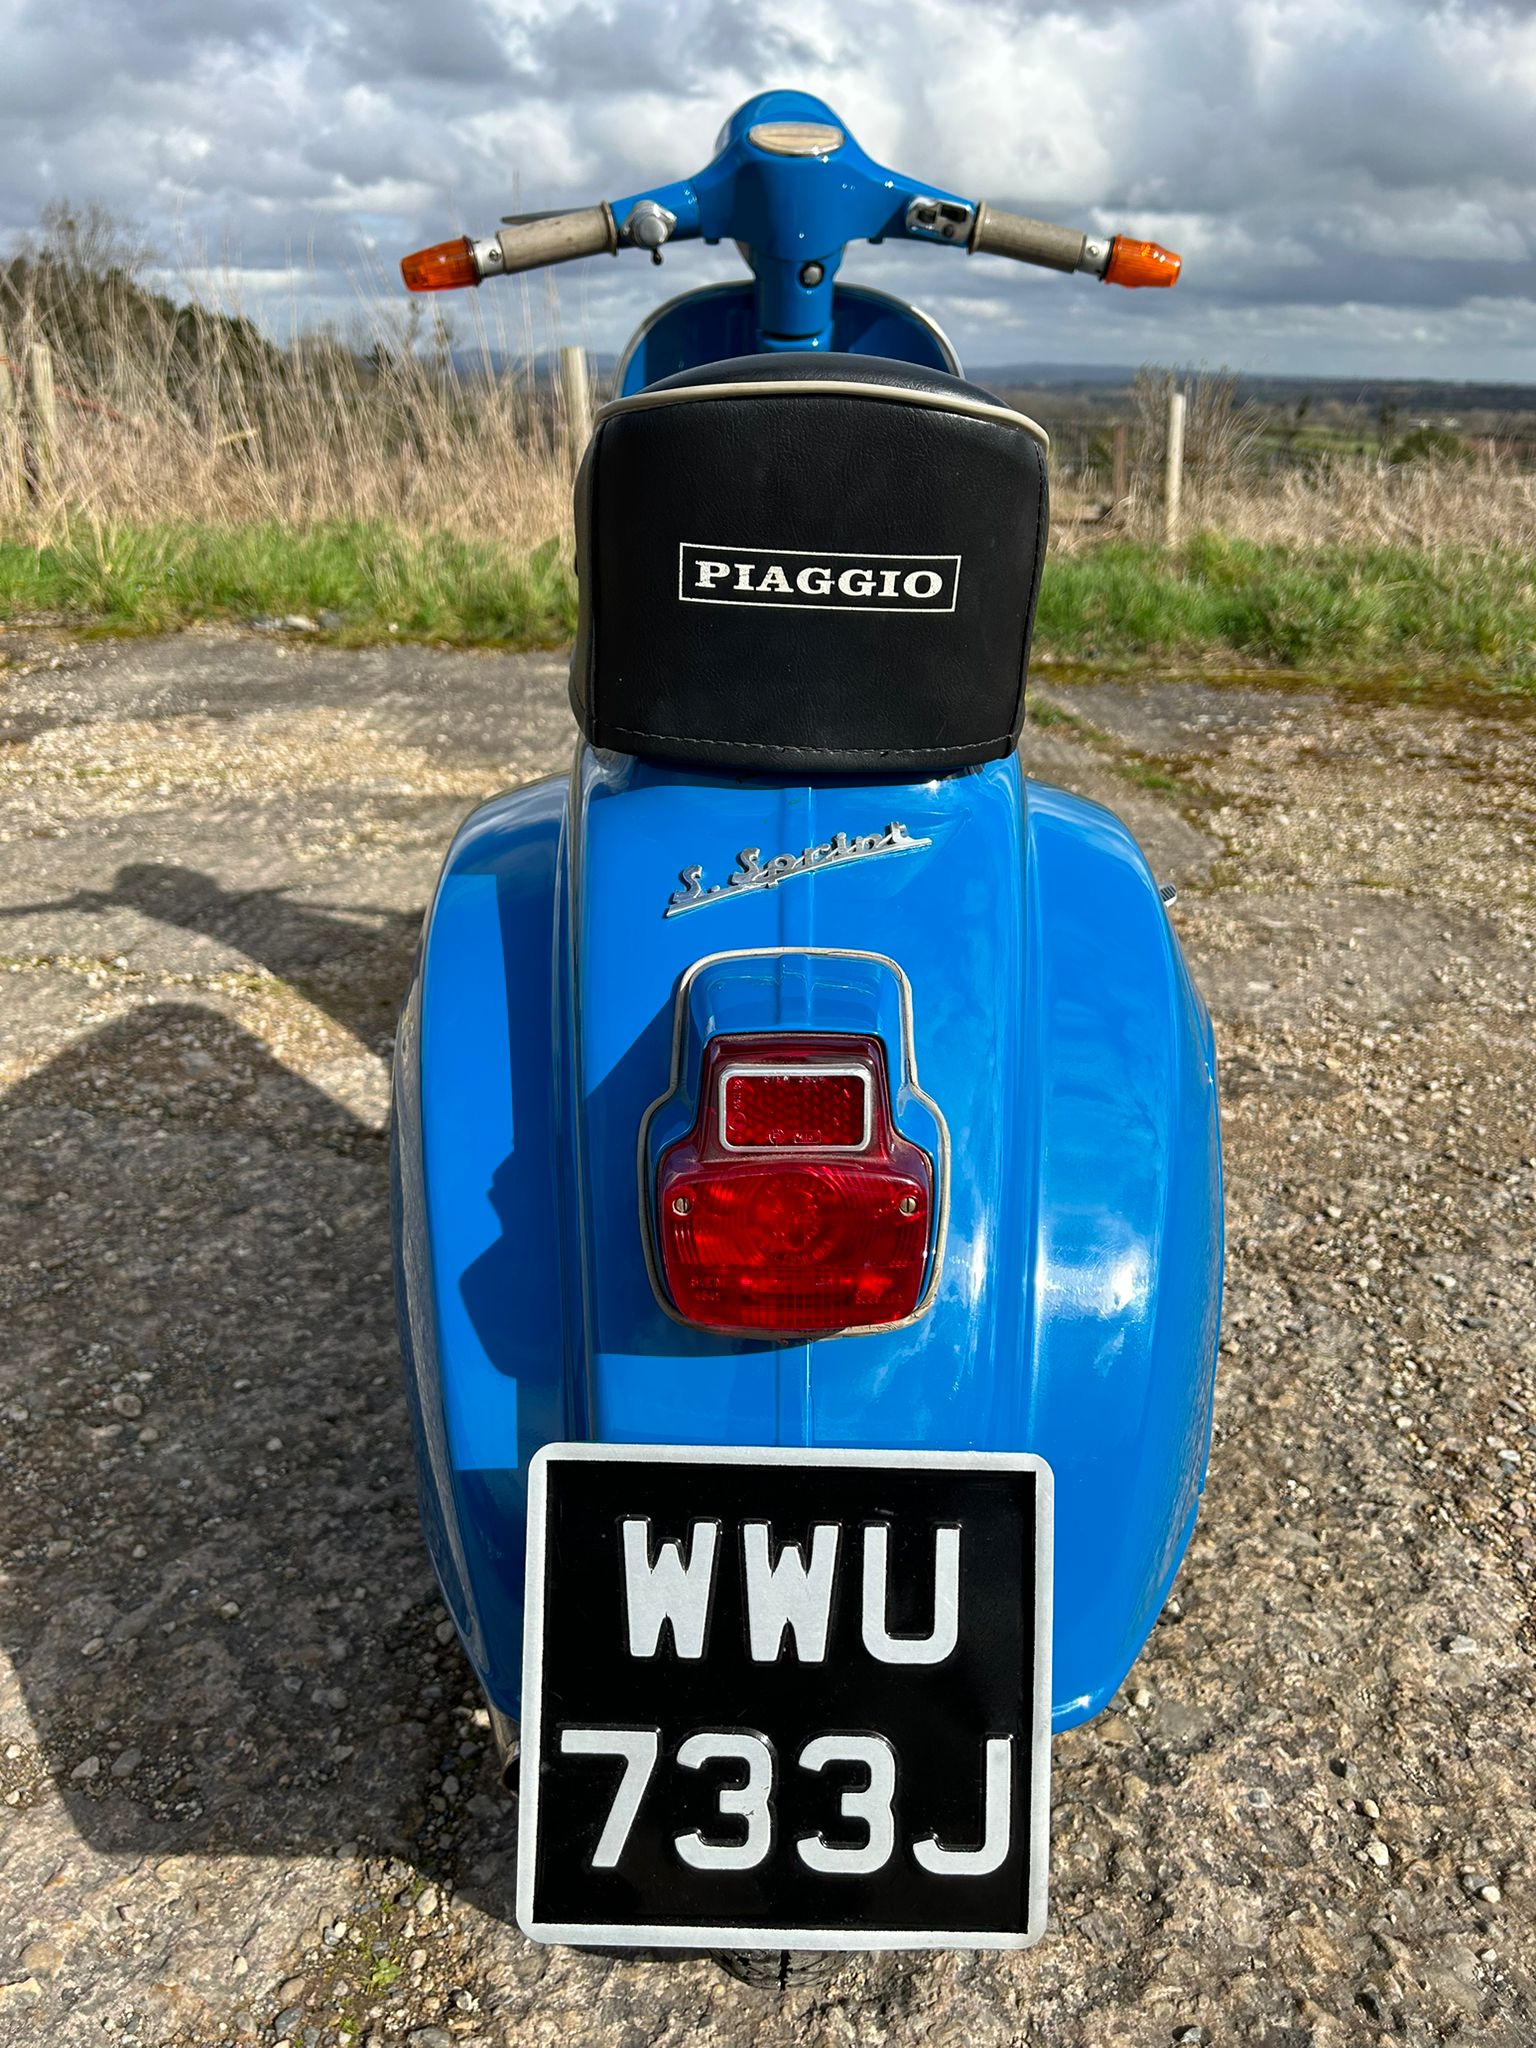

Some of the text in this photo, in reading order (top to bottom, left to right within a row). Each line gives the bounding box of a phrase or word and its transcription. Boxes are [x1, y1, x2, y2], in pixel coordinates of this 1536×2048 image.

[694, 559, 944, 599] PIAGGIO
[731, 821, 910, 889] Sprint
[621, 1518, 961, 1665] WWU
[559, 1728, 1012, 1876] 733J
